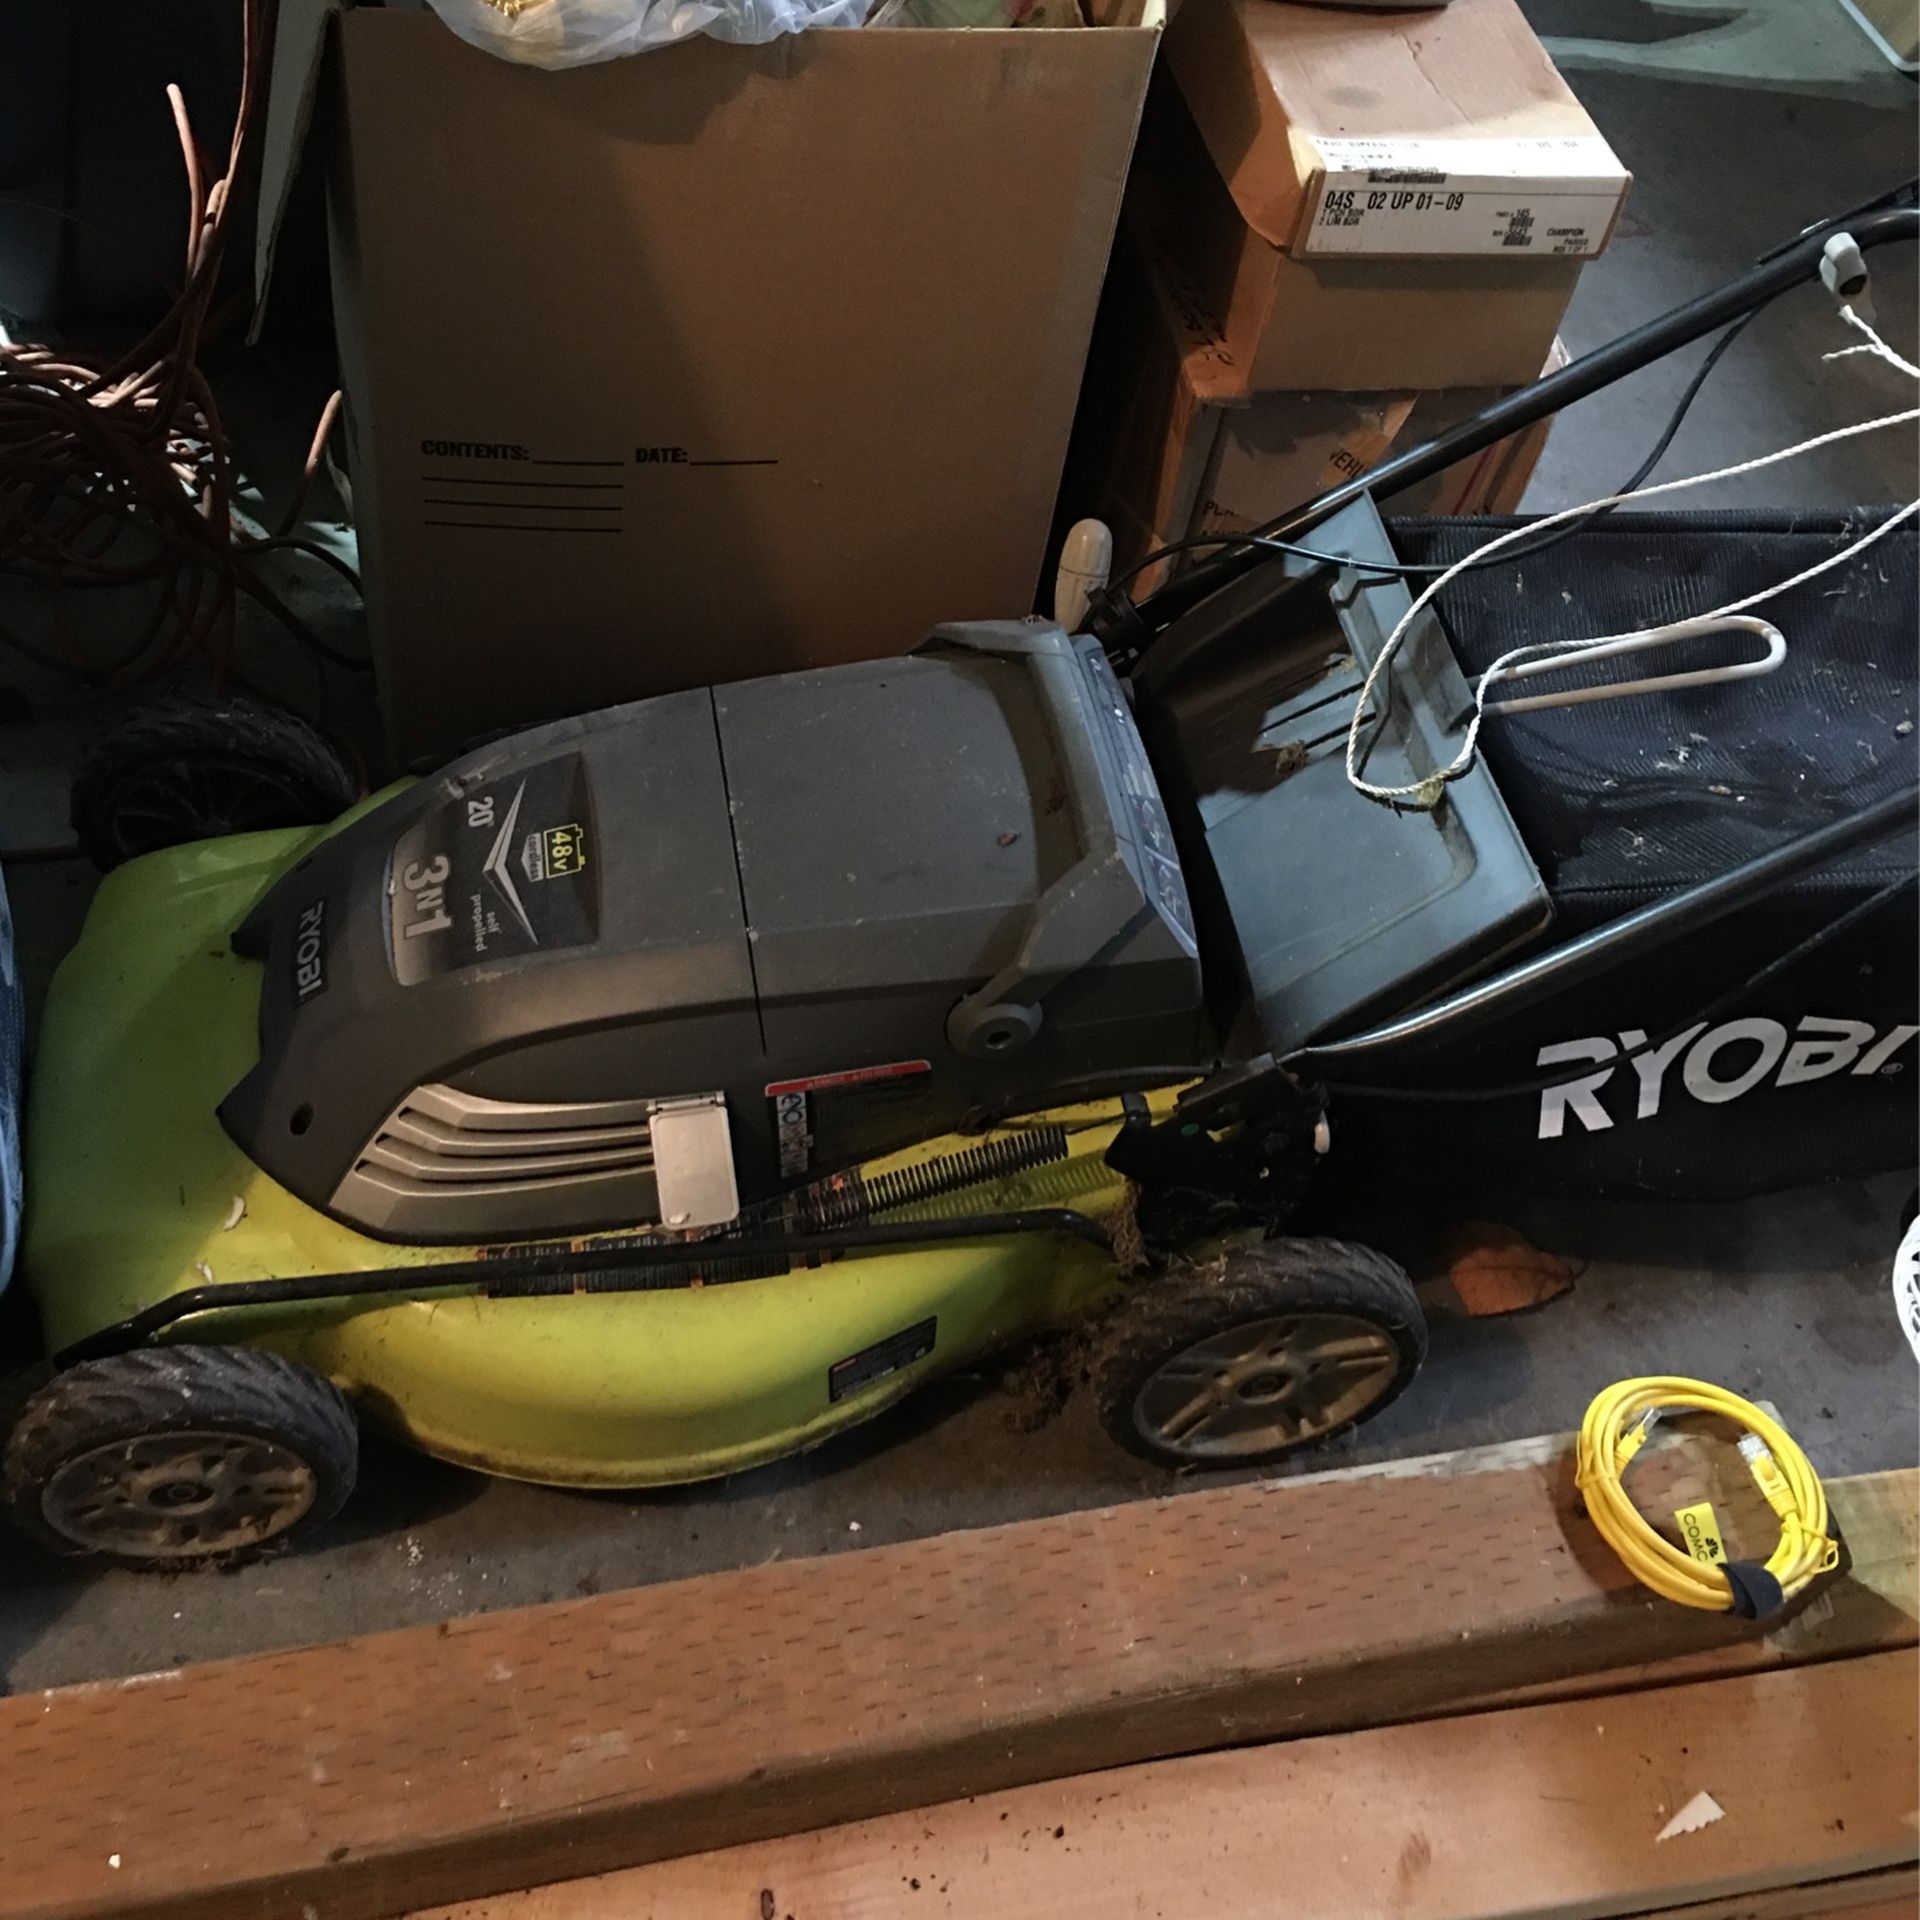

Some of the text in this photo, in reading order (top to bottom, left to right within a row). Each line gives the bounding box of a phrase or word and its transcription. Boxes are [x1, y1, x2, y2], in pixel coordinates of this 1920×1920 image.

[1325, 191, 1464, 211] 04S 02 UP 01-09
[421, 439, 689, 463] CONTENTS: DATE:
[1329, 448, 1364, 479] VEHI
[527, 835, 542, 881] cordless
[469, 893, 489, 953] propelled
[296, 900, 324, 996] RYOBI
[1536, 1015, 1919, 1139] RYOBI
